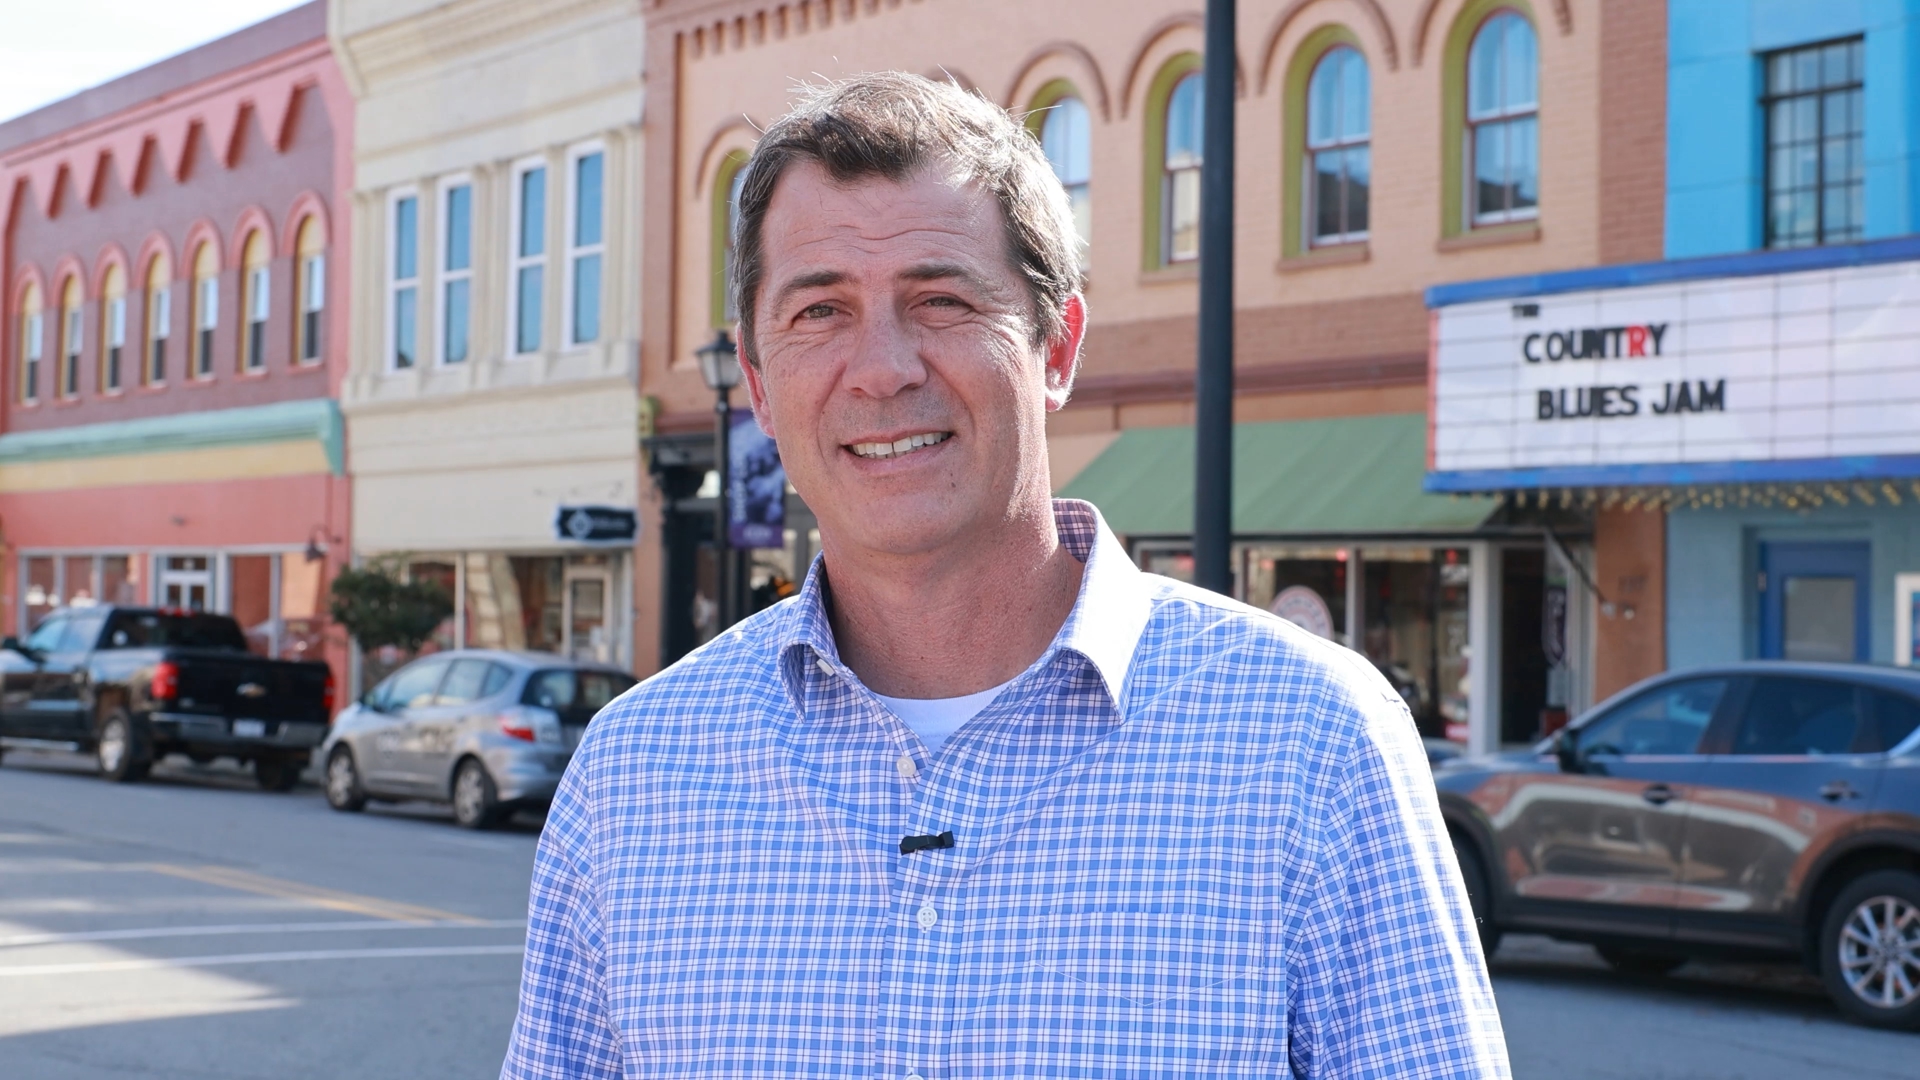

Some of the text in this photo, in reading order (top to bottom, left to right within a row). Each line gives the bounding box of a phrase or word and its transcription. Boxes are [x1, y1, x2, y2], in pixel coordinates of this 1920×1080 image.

[1524, 323, 1668, 363] COUNTRY
[1537, 378, 1725, 420] BLUES JAM
